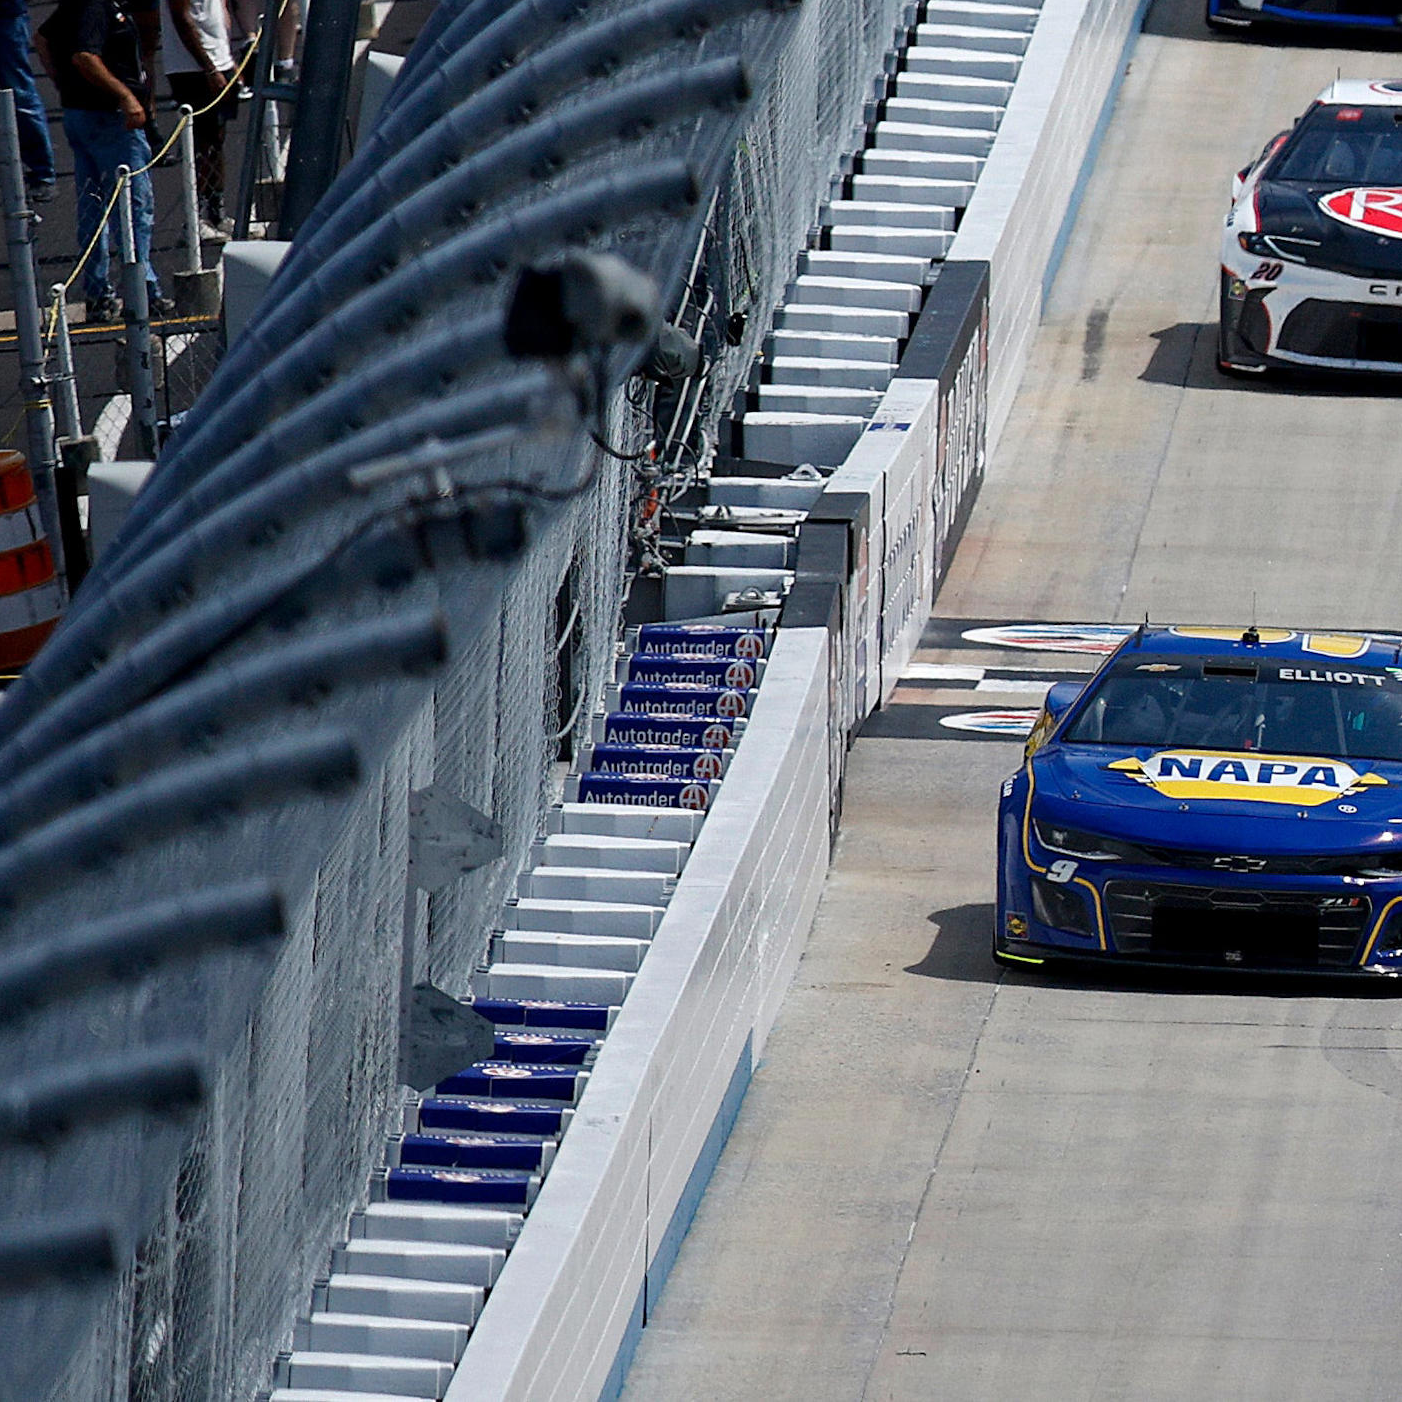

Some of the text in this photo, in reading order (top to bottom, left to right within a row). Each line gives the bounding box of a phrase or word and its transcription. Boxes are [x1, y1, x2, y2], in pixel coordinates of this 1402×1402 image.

[1250, 261, 1284, 282] 20
[644, 641, 732, 656] Autotrader
[635, 671, 722, 686] Autotrader
[1279, 668, 1386, 687] ELLIOTT
[623, 700, 714, 715] Autotrader
[607, 728, 699, 745] Autotrader
[600, 760, 690, 776] Autotrader
[1158, 756, 1340, 788] NAPA
[585, 790, 676, 807] Autotrader
[1046, 859, 1079, 884] 9
